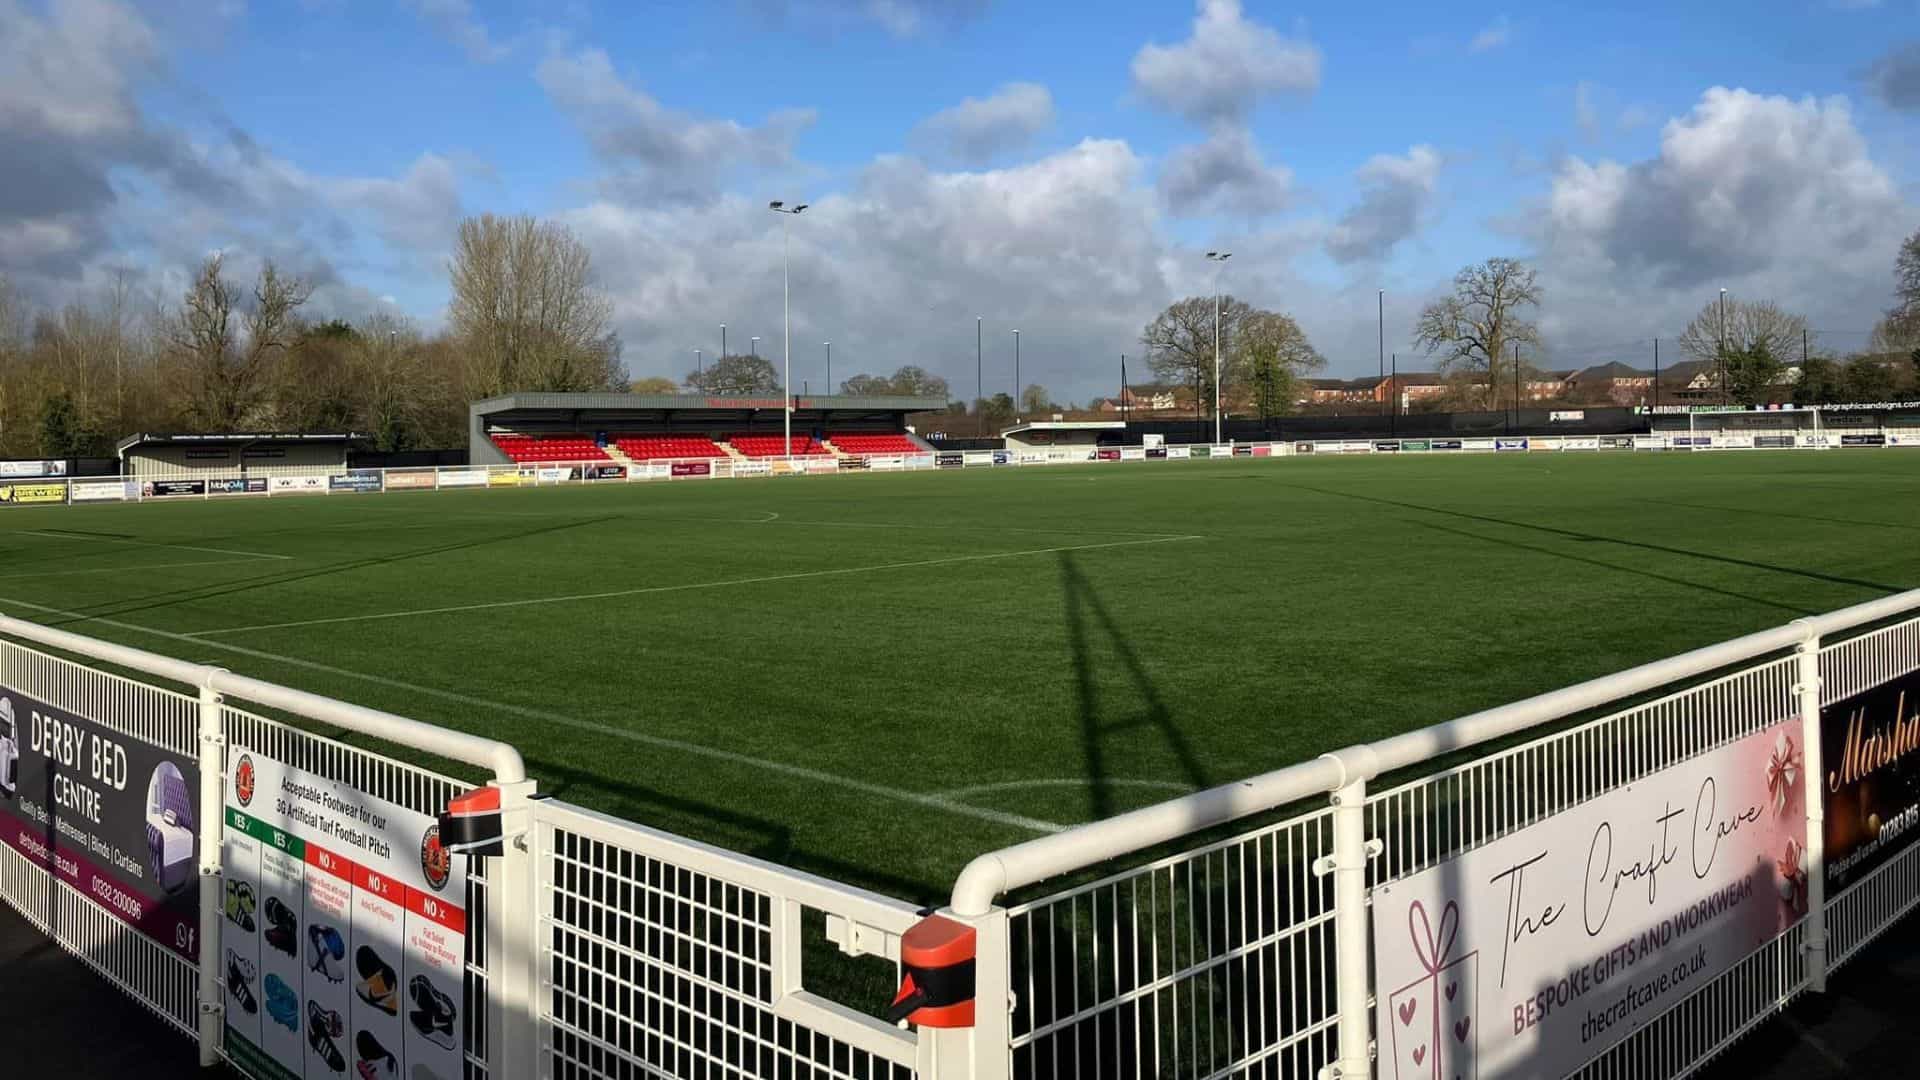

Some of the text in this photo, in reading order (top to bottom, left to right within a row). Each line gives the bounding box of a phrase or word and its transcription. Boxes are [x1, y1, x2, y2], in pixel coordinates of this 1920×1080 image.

[31, 711, 128, 791] DERBY BED
[54, 774, 101, 824] CENTRE
[234, 812, 246, 830] YES
[281, 776, 321, 804] Acceptable
[322, 792, 358, 819] Footwear
[360, 806, 371, 825] for
[372, 815, 386, 830] our
[55, 815, 87, 846] Mattresses
[92, 835, 110, 859] Blinds
[114, 849, 143, 878] Curtains
[273, 829, 286, 848] YES
[276, 798, 390, 860] 3G Artificial Turf Football Pitch
[1828, 857, 1850, 881] Please
[1851, 846, 1861, 866] call
[1880, 812, 1904, 846] 01283
[319, 851, 330, 869] NO
[368, 873, 380, 892] NO
[1490, 776, 1763, 989] The Craft Cave
[92, 875, 142, 920] 01332 200096
[423, 897, 437, 918] NO
[1513, 875, 1752, 1036] BESPOKE GIFTS AND WORKWEAR
[1581, 943, 1707, 1044] thecraftcave.co.uk
